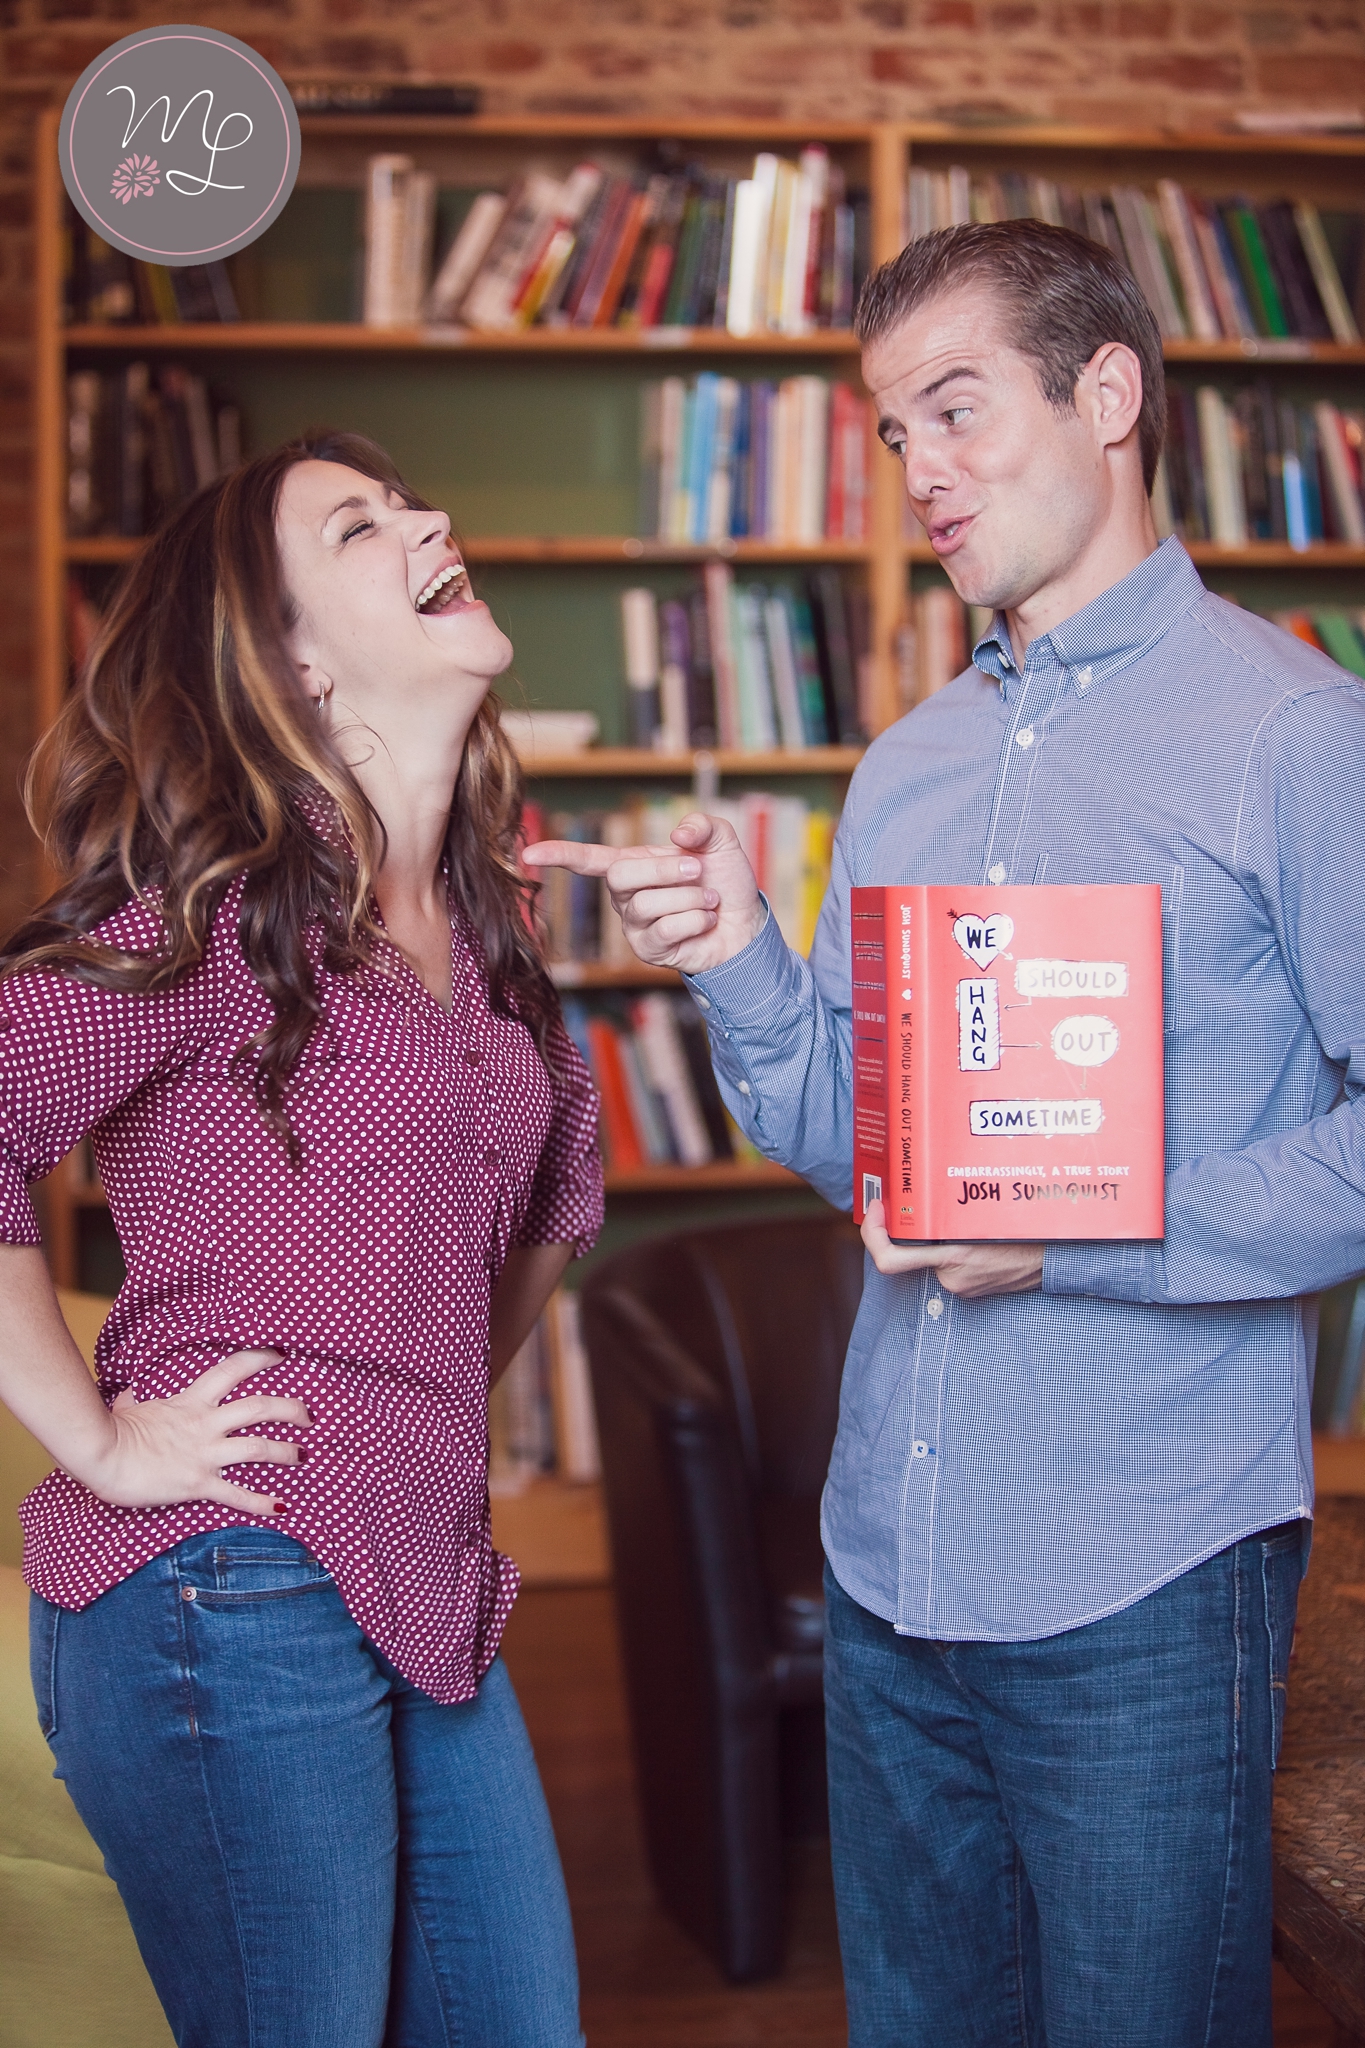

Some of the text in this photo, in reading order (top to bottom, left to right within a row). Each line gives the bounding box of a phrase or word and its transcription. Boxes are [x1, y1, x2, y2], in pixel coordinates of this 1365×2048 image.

[900, 904, 912, 979] JOSH SUNDQUIST
[966, 926, 997, 949] WE
[1028, 969, 1117, 989] SHOULD
[969, 985, 987, 1065] HANG
[1060, 1031, 1112, 1052] OUT
[901, 1012, 912, 1194] WE SHOULD HANG OUT SOMETIME
[979, 1107, 1092, 1128] SOMETIME
[947, 1166, 1130, 1178] EMBARRASSINGLY, A TRUE STORY
[957, 1181, 1121, 1205] JOSH SUNDQUIST
